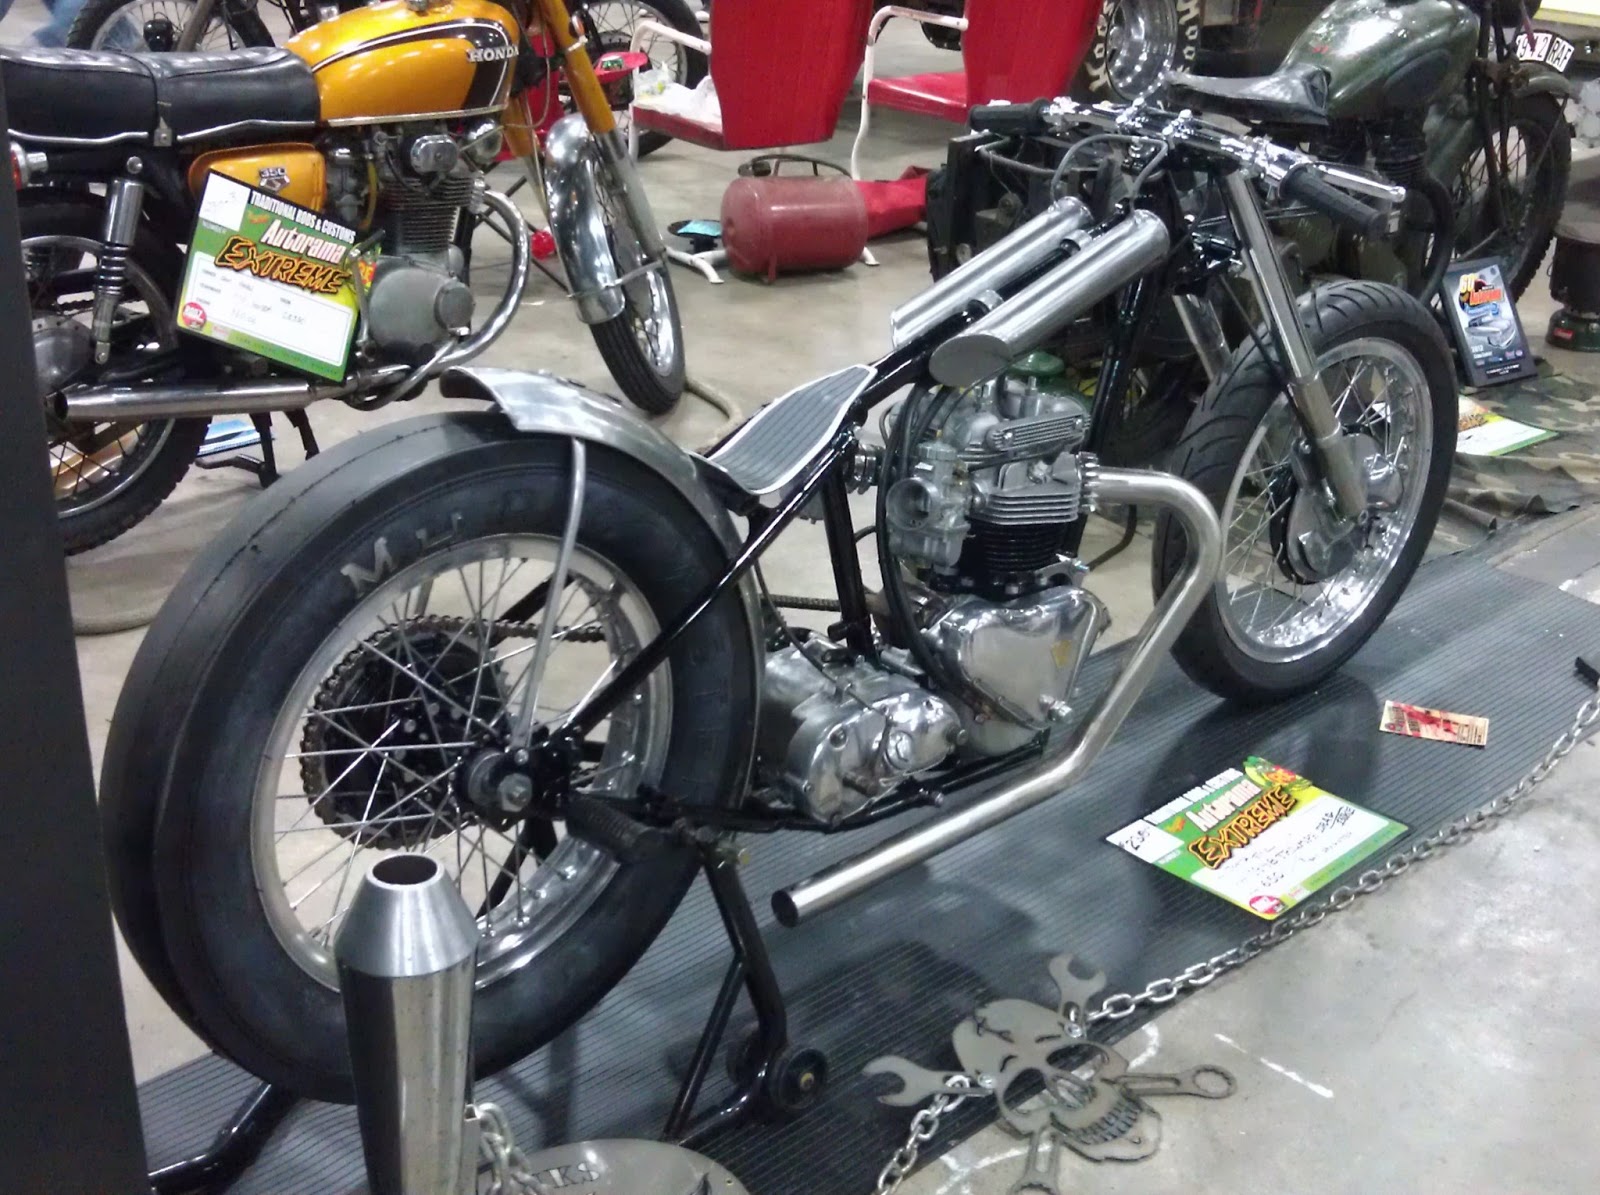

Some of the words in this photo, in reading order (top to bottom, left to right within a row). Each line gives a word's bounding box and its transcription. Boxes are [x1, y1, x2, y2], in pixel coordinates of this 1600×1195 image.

[468, 45, 519, 62] HONDA
[1546, 38, 1573, 70] RAF
[250, 190, 297, 221] TRADITIONAL
[321, 219, 356, 244] CUSTOMS
[260, 219, 347, 264] Autorama
[214, 235, 351, 293] EXTREME
[1185, 778, 1262, 832] Autorama
[1188, 785, 1298, 870] EXTREME
